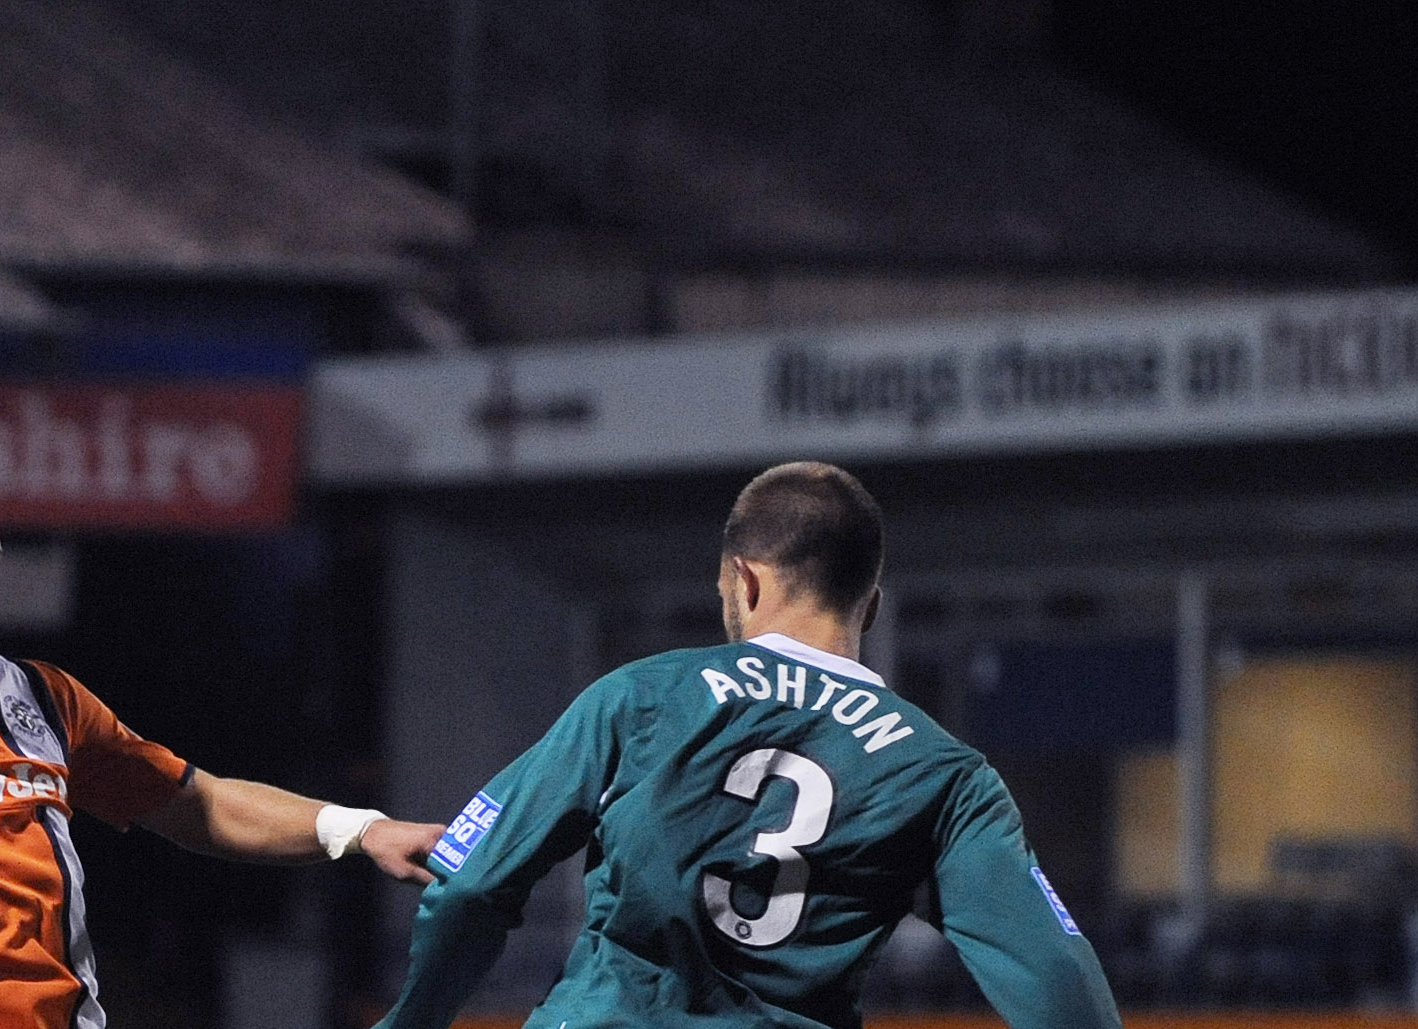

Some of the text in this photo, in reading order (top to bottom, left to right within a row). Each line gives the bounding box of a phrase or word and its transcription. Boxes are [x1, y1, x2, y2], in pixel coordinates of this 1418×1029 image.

[700, 656, 915, 753] ASHTON
[446, 814, 477, 843] SQ
[702, 747, 834, 946] 3
